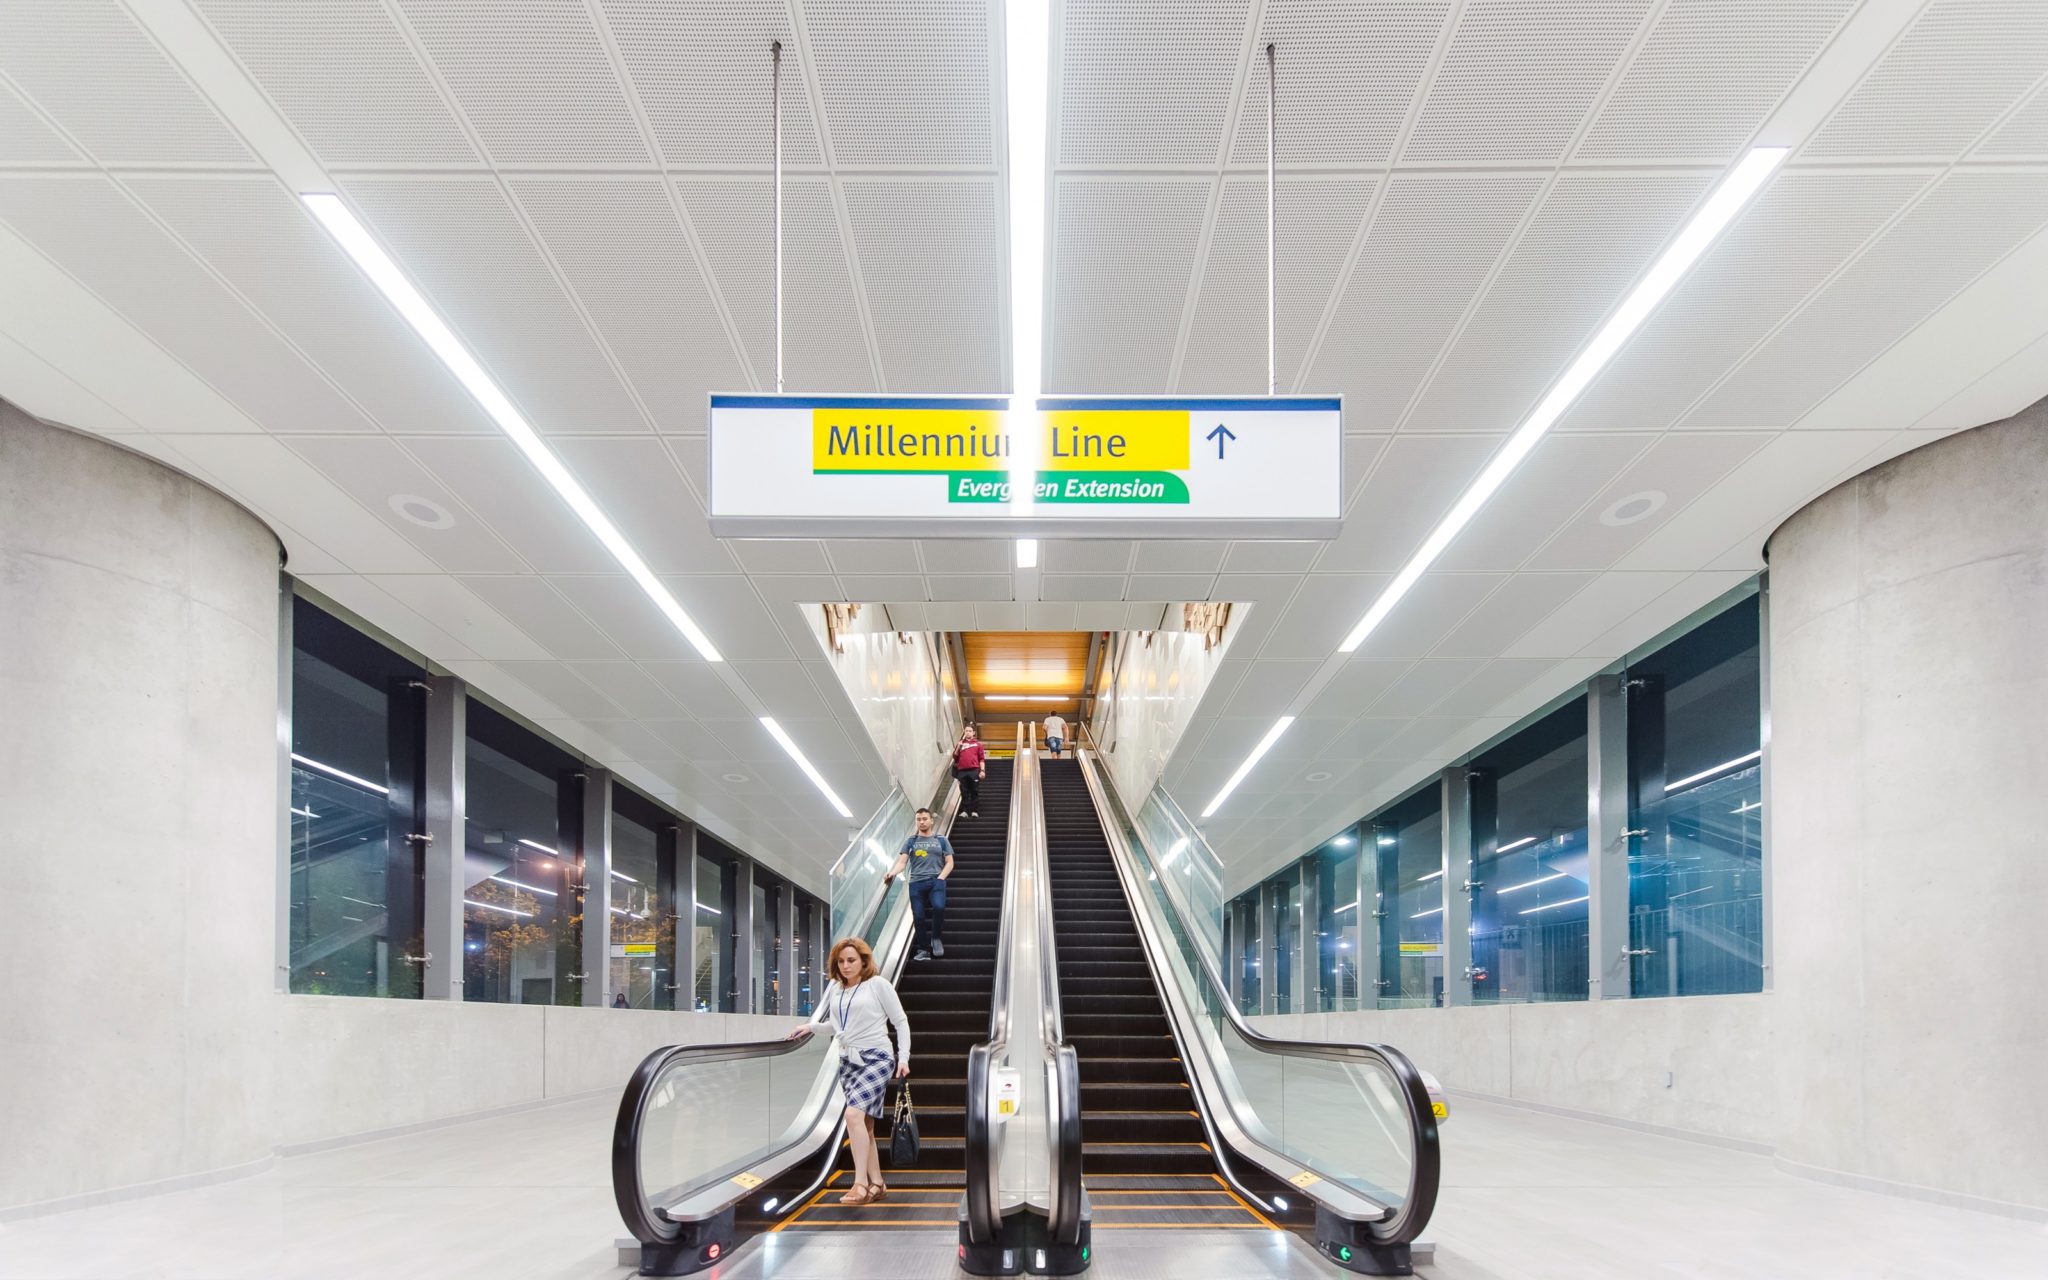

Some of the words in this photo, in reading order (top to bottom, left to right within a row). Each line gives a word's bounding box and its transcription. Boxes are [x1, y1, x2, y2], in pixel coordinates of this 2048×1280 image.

[828, 424, 1011, 457] Millenniu
[1052, 425, 1127, 457] Line
[957, 478, 1058, 501] Evergen
[1064, 477, 1164, 498] Extension
[1432, 1103, 1445, 1116] 2
